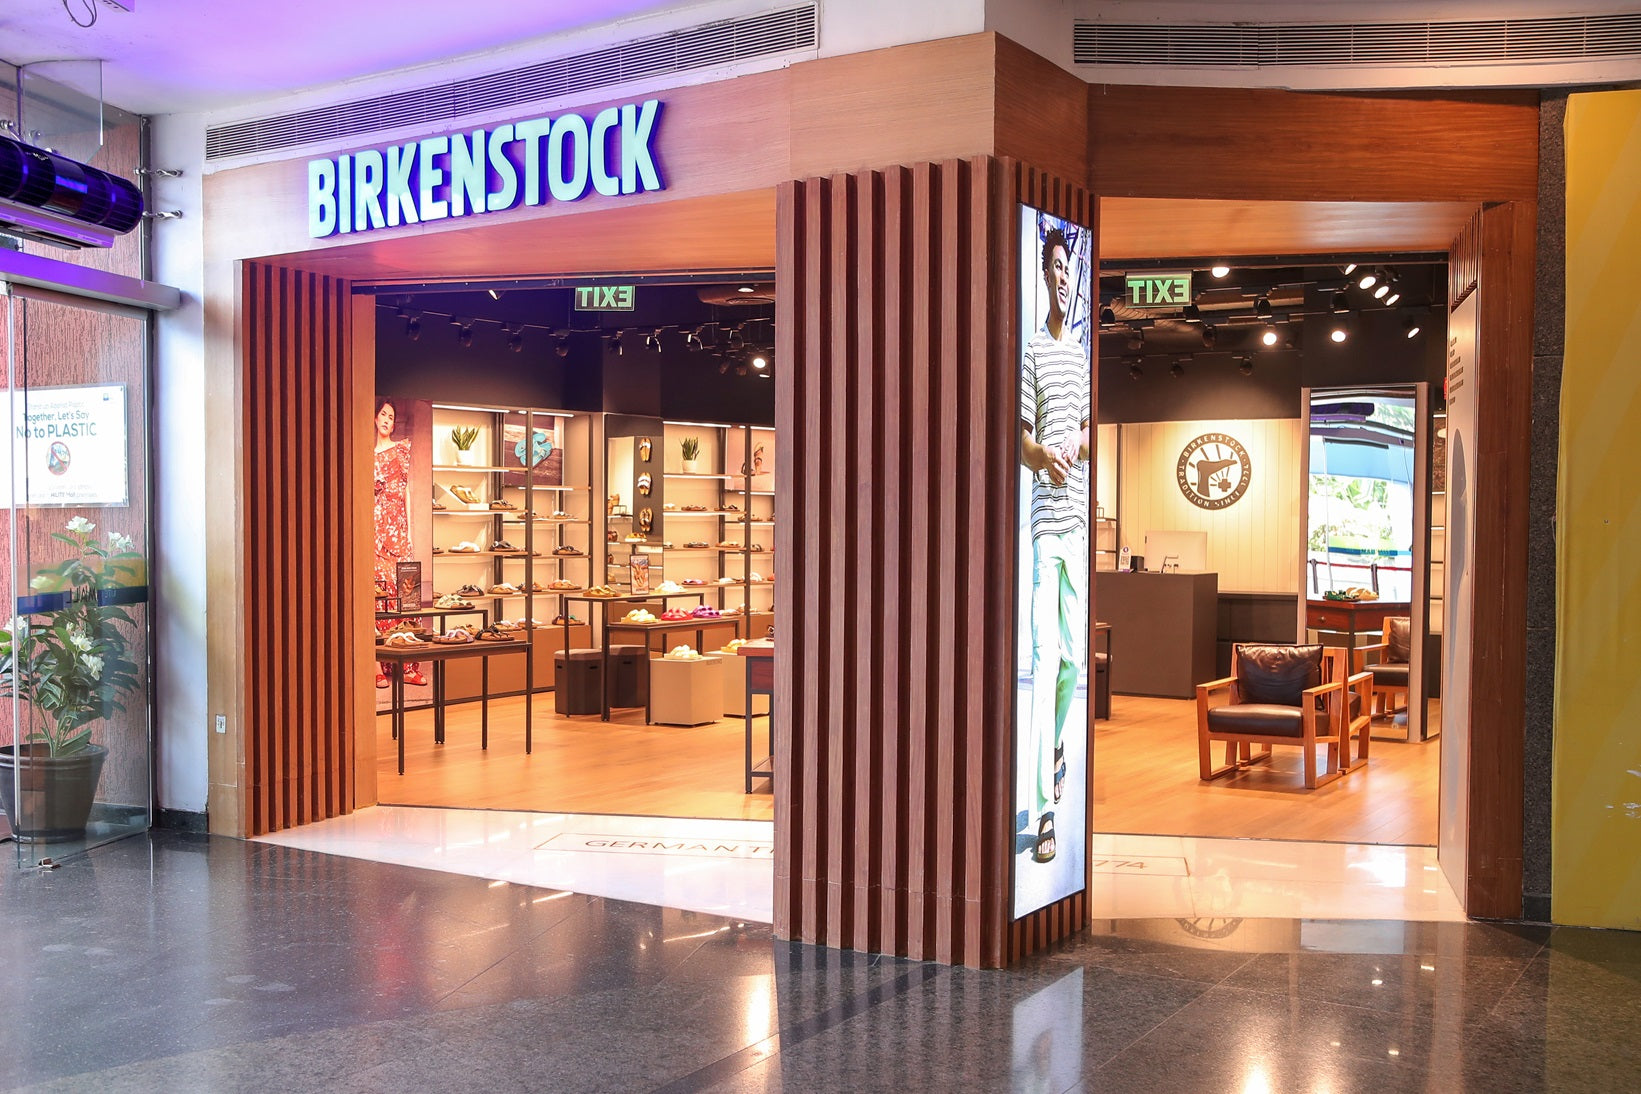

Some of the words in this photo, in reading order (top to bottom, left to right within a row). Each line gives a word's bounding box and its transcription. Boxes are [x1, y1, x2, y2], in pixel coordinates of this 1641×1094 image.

[308, 99, 662, 238] BIRKENSTOCK
[58, 411, 75, 421] Let's
[76, 409, 90, 421] Say
[16, 425, 32, 439] No
[34, 426, 46, 439] to
[47, 422, 97, 438] PLASTIC
[1183, 434, 1246, 458] BIRKENSTOCK
[1178, 465, 1210, 507] TRADITION
[585, 840, 740, 853] GERMAN
[1093, 859, 1148, 870] 774
